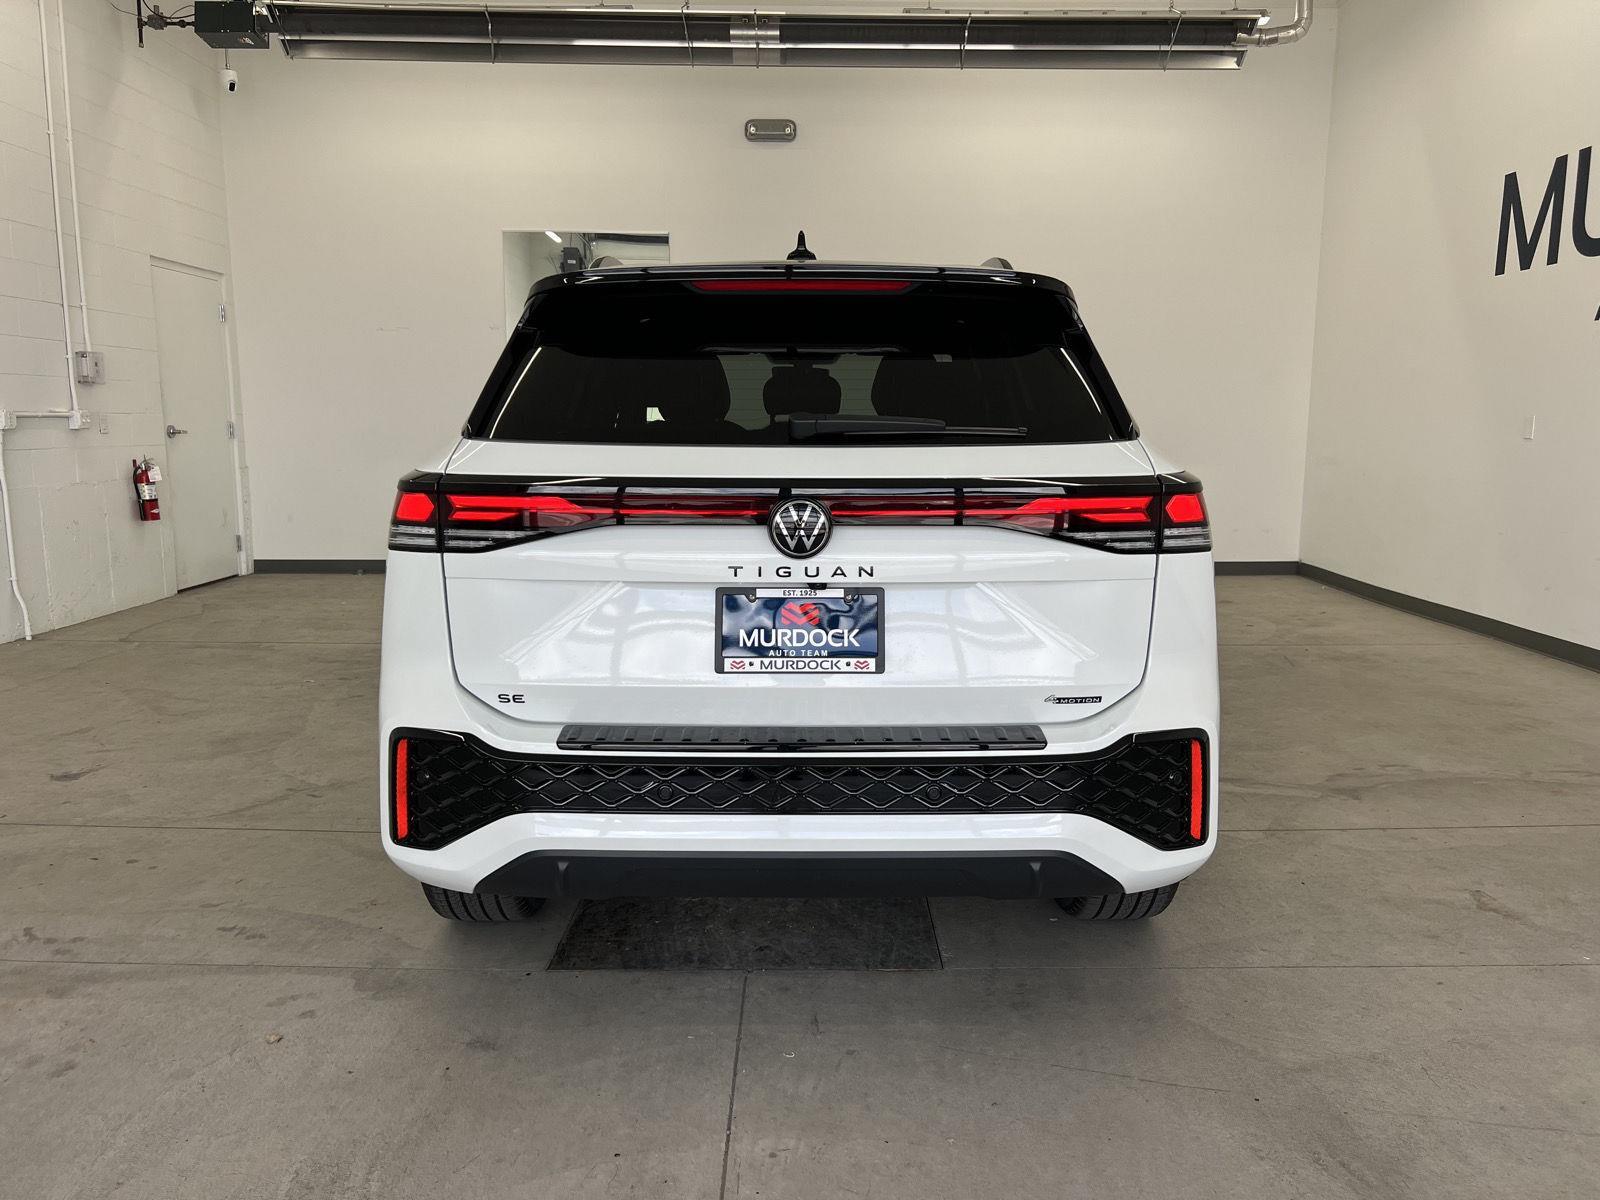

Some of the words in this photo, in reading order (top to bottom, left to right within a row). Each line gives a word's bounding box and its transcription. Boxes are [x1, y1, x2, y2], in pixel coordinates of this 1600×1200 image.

[728, 566, 874, 578] TIGUAN
[783, 589, 798, 597] EST.
[800, 589, 818, 597] 1925
[739, 629, 861, 647] MURDOCK
[769, 649, 796, 657] AUTO
[801, 649, 828, 657] TEAM
[760, 660, 842, 671] MURDOCK
[497, 693, 526, 704] SE
